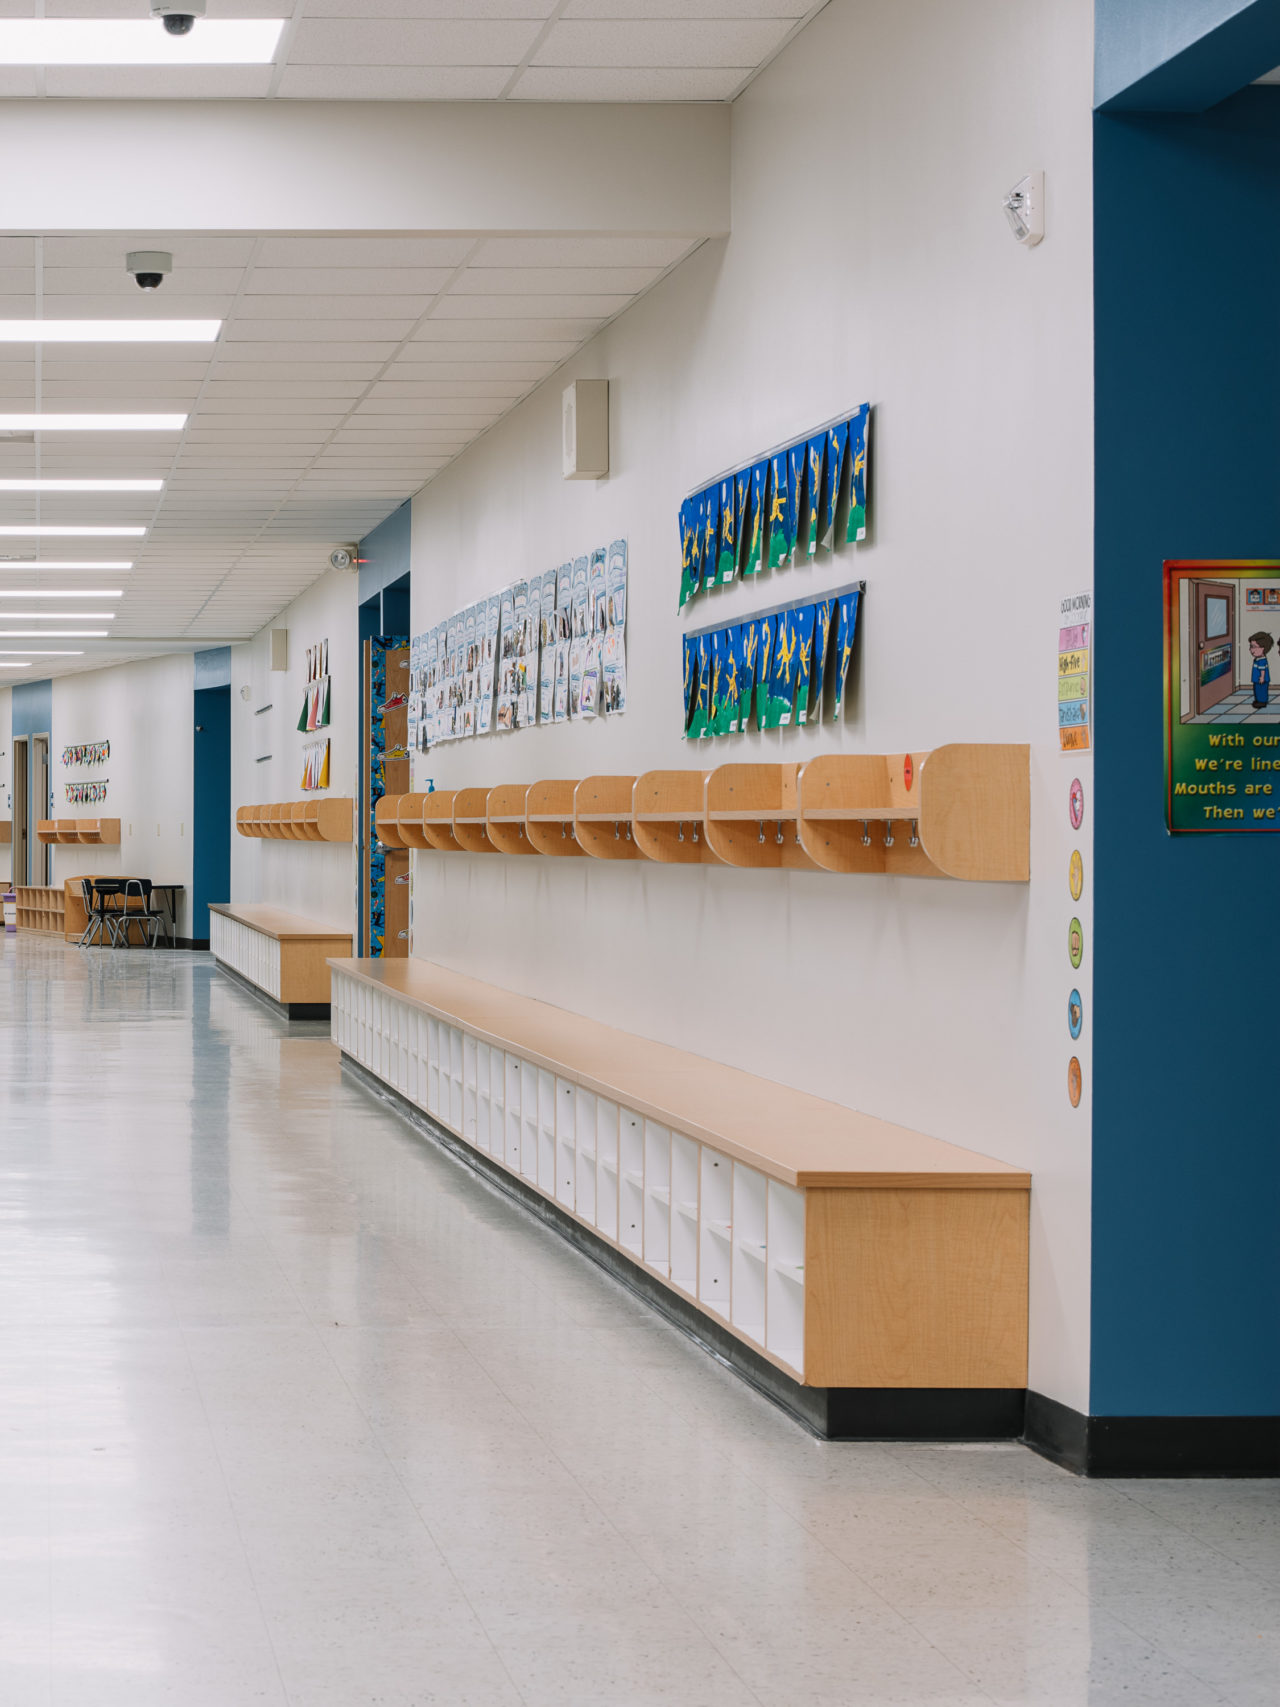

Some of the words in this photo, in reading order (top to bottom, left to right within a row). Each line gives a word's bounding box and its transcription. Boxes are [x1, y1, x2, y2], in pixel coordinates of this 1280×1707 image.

[1208, 734, 1245, 747] With
[1252, 736, 1280, 746] our
[1194, 758, 1243, 771] We're
[1174, 782, 1237, 794] Mouths
[1244, 784, 1273, 794] are
[1203, 806, 1244, 818] Then
